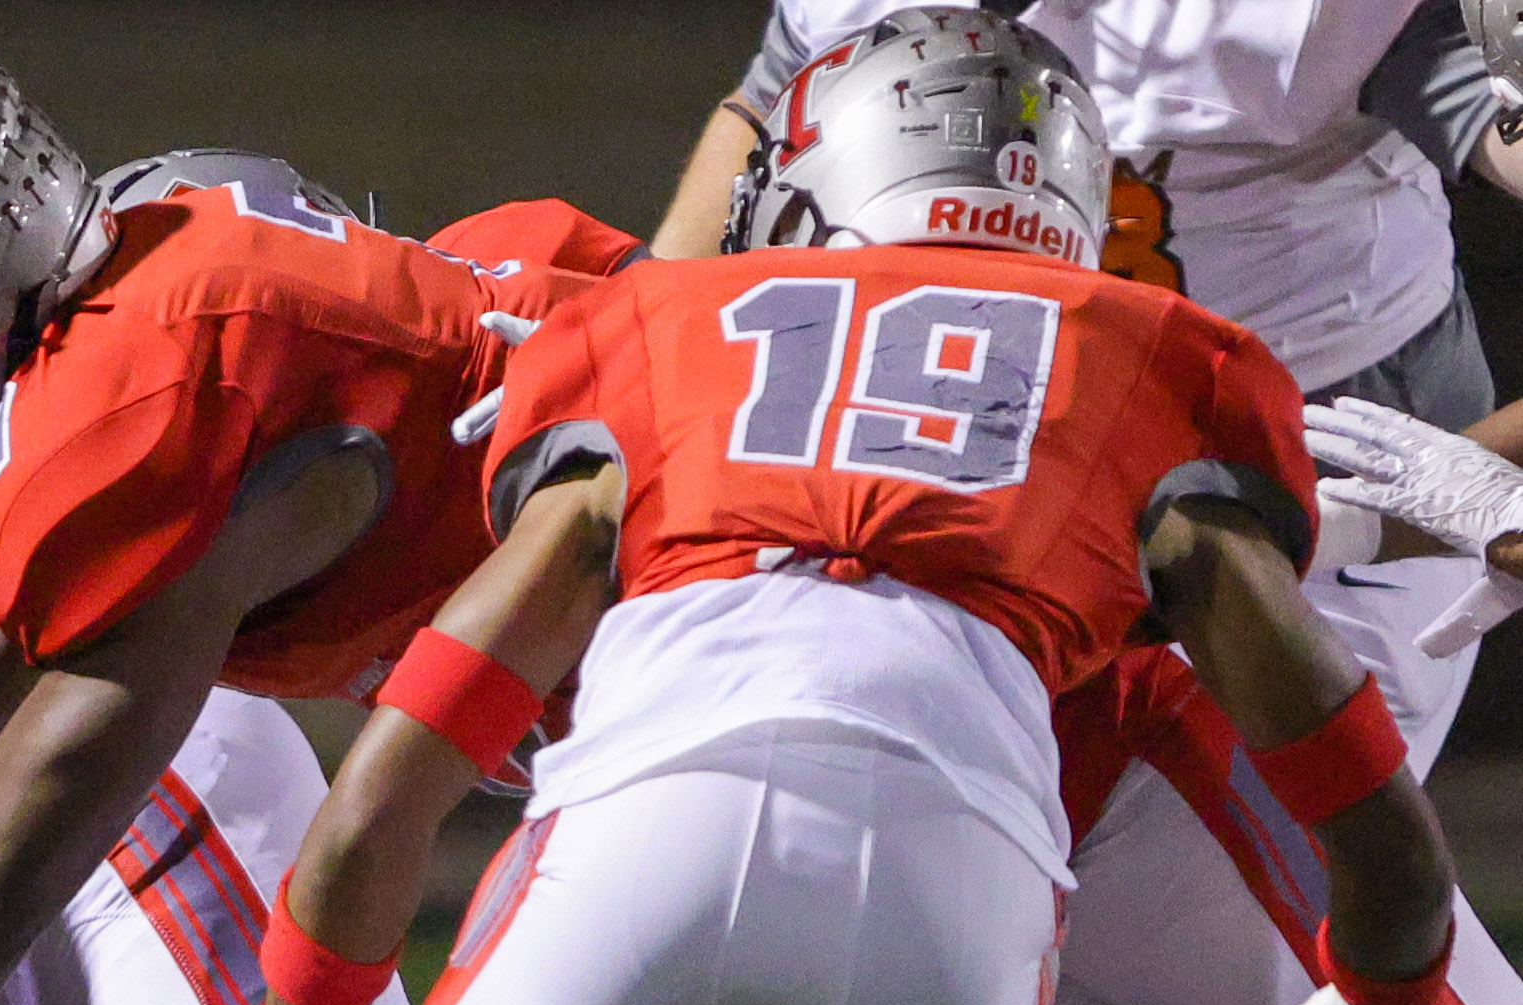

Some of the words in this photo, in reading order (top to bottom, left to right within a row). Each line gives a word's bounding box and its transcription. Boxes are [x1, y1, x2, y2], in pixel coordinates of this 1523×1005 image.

[1008, 149, 1038, 186] 19
[928, 197, 1086, 264] Riddell
[719, 277, 1062, 494] 19
